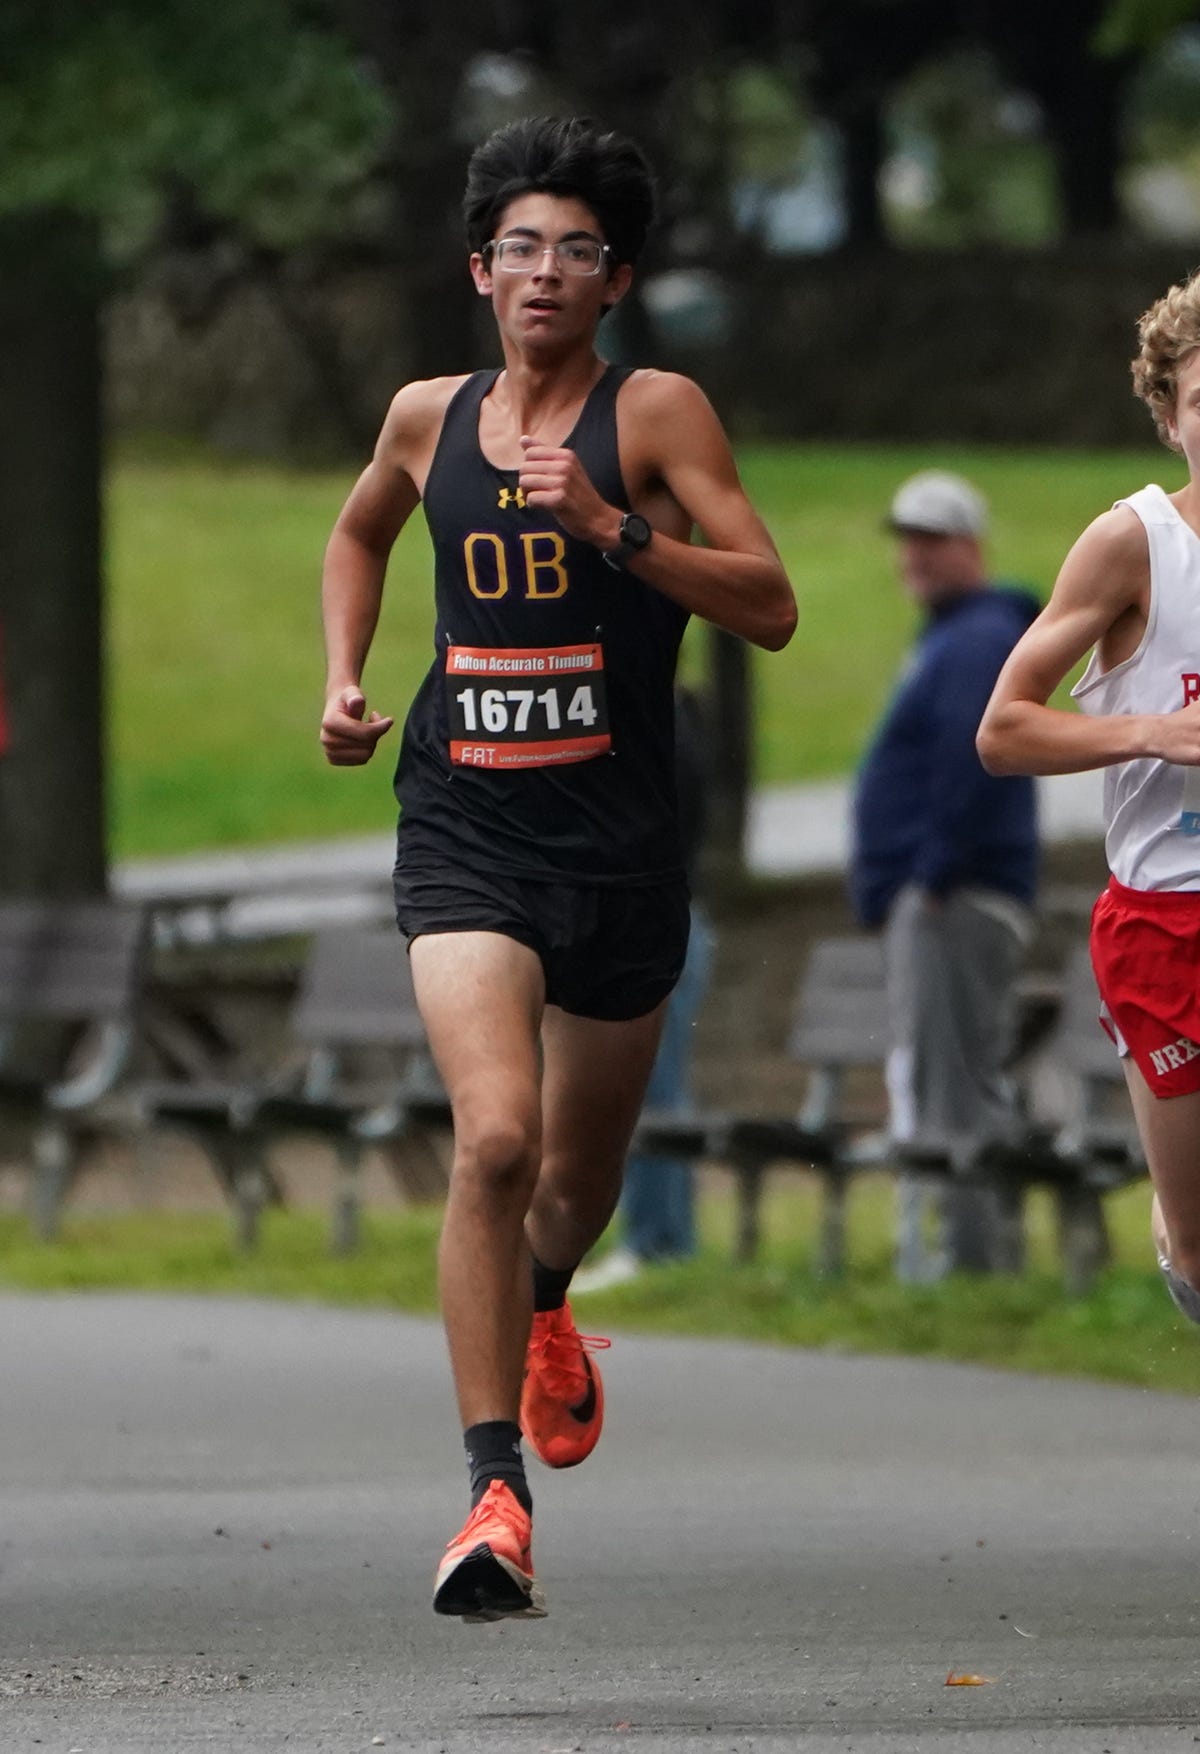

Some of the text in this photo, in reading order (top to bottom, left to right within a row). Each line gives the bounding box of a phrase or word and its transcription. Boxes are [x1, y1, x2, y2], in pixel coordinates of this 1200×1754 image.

[463, 531, 569, 599] OB
[454, 653, 593, 671] Fulton Accurate Timing
[456, 686, 598, 732] 16714
[461, 747, 496, 764] FAT
[1149, 1037, 1200, 1076] NRX
